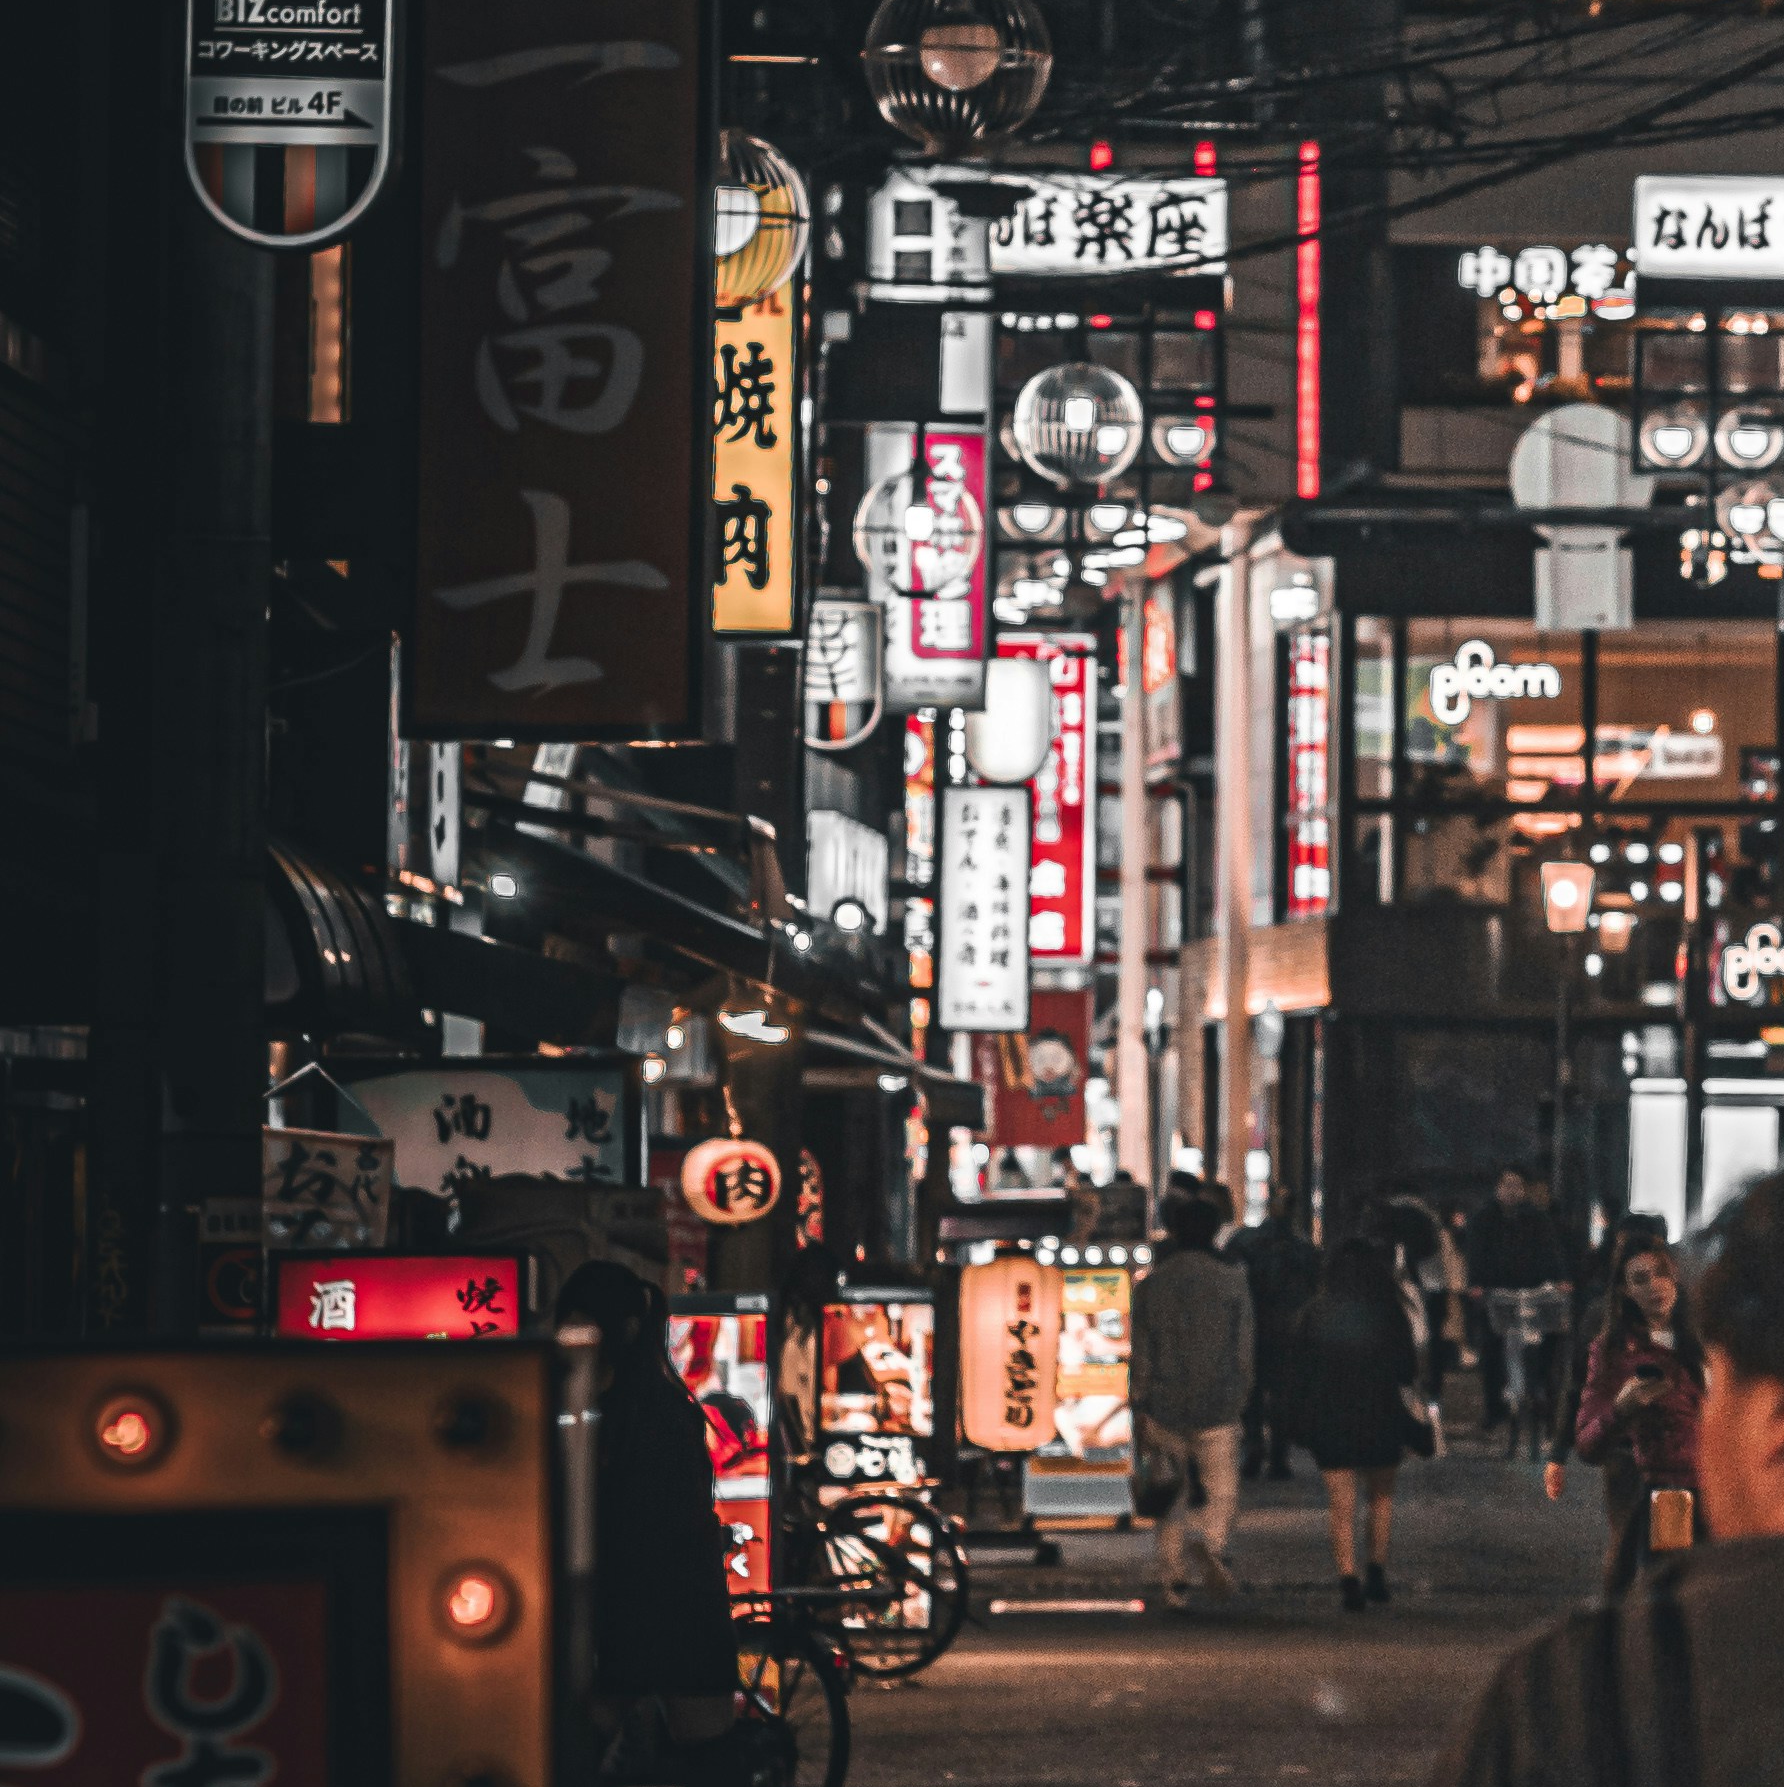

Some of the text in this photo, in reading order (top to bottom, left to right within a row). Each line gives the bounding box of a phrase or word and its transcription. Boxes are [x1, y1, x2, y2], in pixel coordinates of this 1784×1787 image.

[198, 39, 379, 62] コワーキングスペース
[308, 90, 344, 115] 4F
[714, 341, 779, 591] 焼肉
[714, 1158, 773, 1215] 肉
[308, 1277, 358, 1333] 酒
